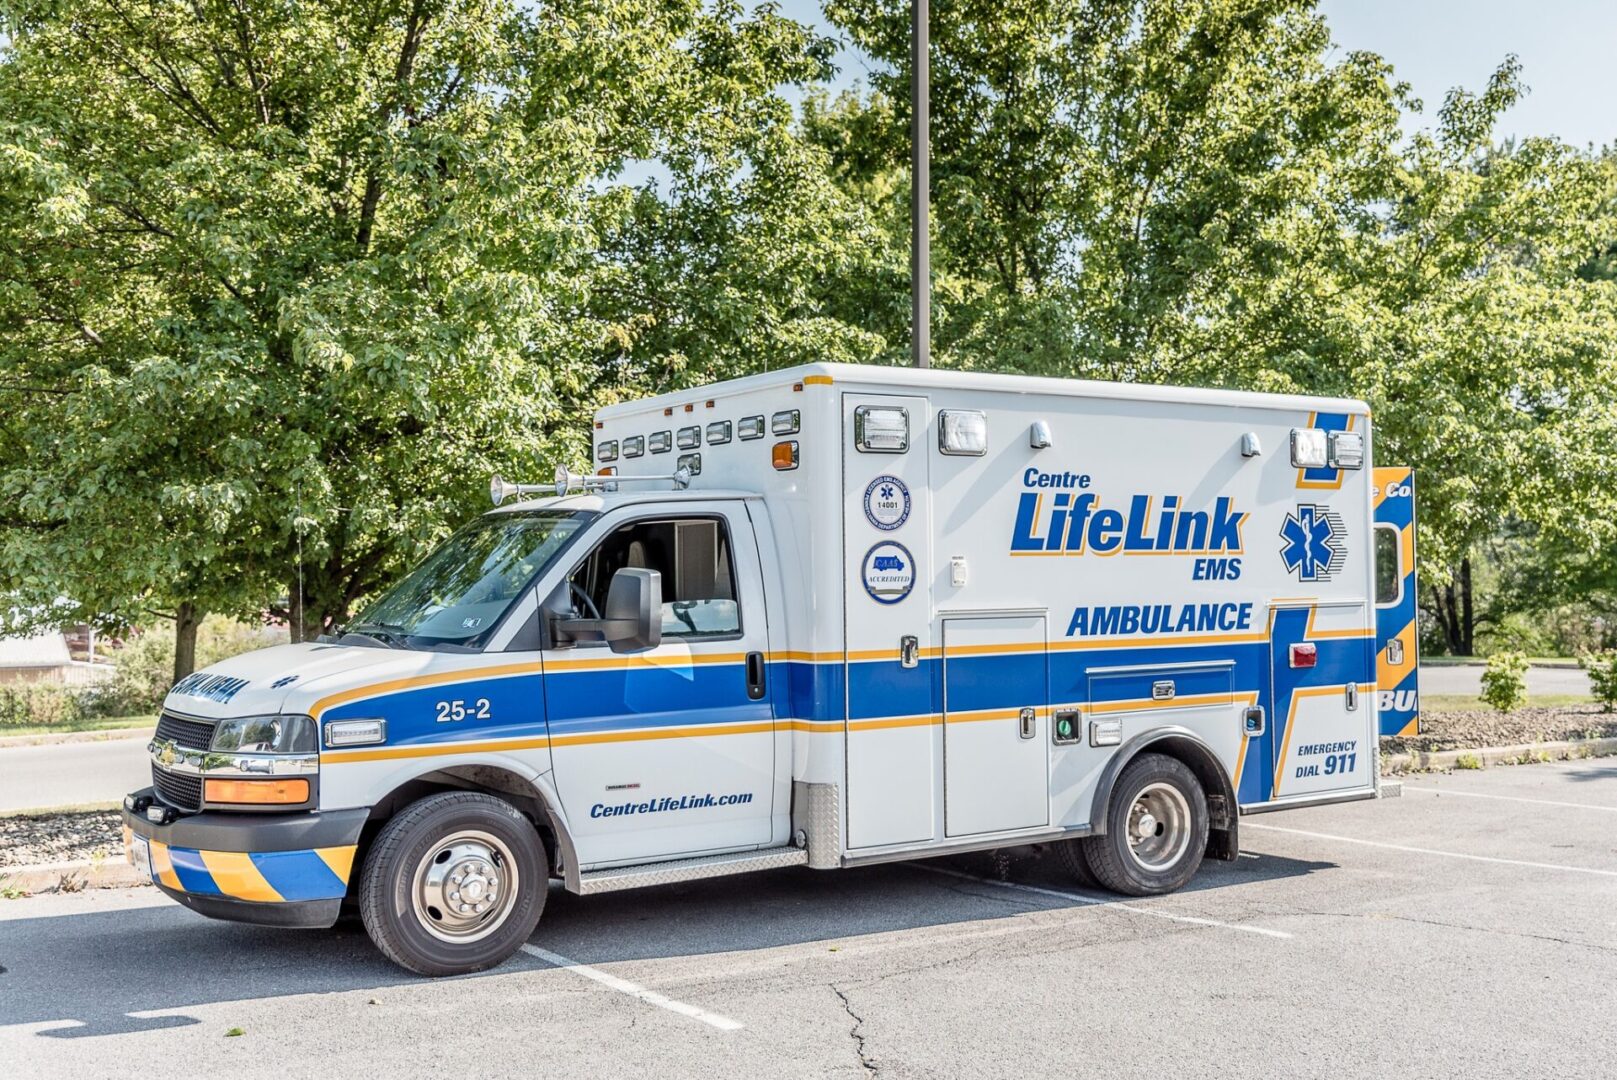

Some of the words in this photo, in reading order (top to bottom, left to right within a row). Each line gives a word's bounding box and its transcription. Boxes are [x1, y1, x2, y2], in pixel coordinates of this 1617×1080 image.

[1024, 467, 1091, 488] Centre
[1385, 481, 1412, 498] Co
[877, 501, 898, 509] 14001
[1010, 492, 1249, 556] LifeLink
[869, 575, 910, 583] ACCREDITED
[1192, 558, 1242, 580] EMS
[1065, 602, 1254, 637] AMBULANCE
[435, 698, 491, 722] 25-2
[1376, 689, 1418, 712] BU
[1297, 740, 1357, 757] EMERGENCY
[1295, 764, 1320, 778] DIAL
[1323, 752, 1357, 775] 911
[590, 793, 753, 819] CentreLifeLink.com
